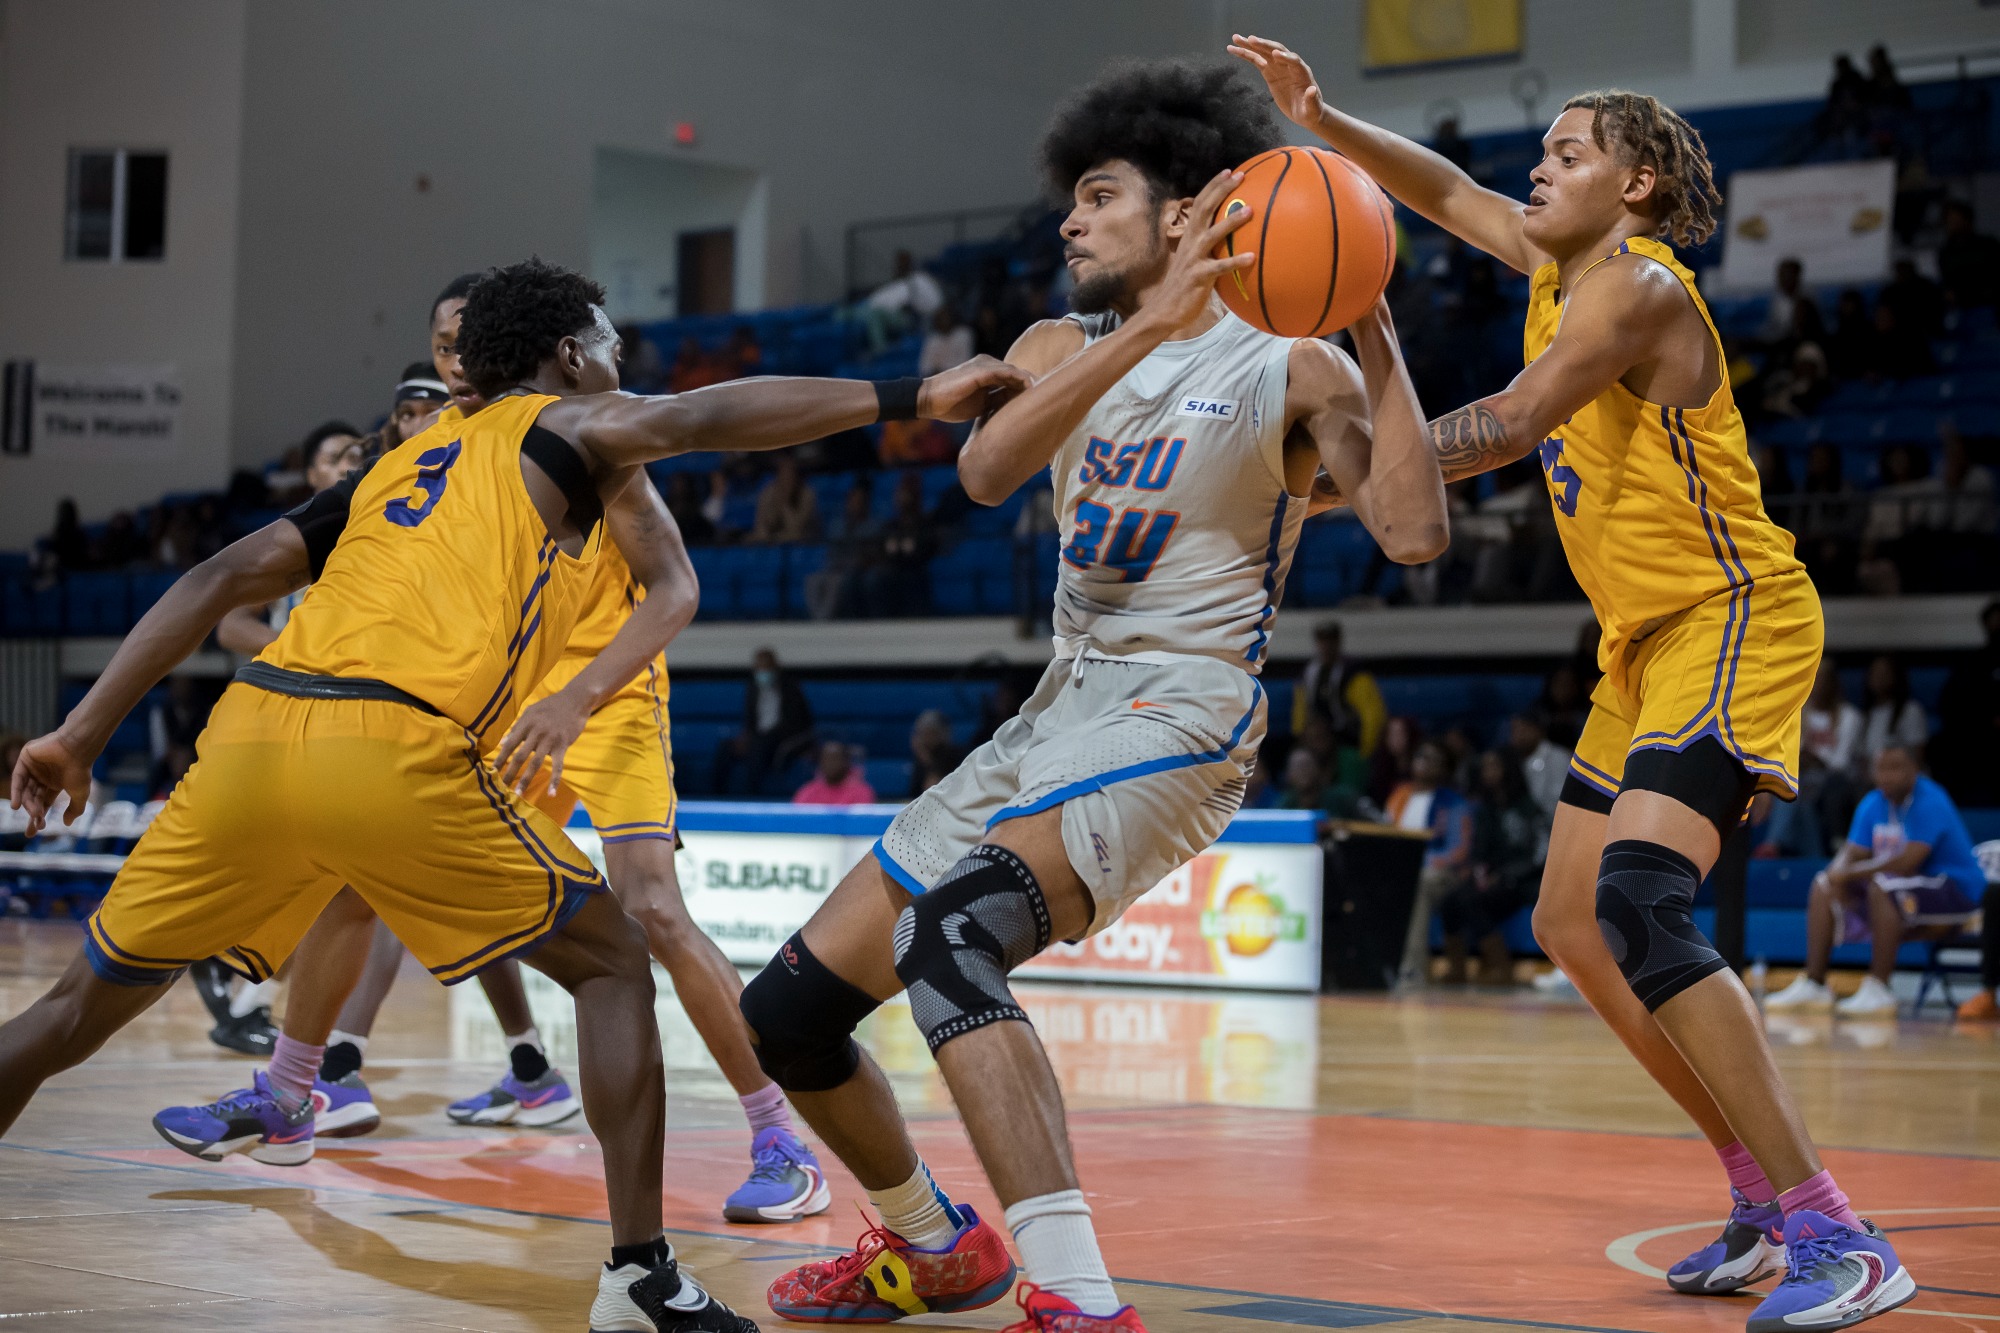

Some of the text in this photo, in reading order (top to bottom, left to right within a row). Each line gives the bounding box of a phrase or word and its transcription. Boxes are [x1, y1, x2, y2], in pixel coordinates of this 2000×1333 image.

[1184, 400, 1232, 416] SIAC
[383, 437, 462, 527] 3
[1079, 435, 1188, 493] SSU
[1062, 497, 1181, 583] 24
[705, 860, 830, 892] SUBARU
